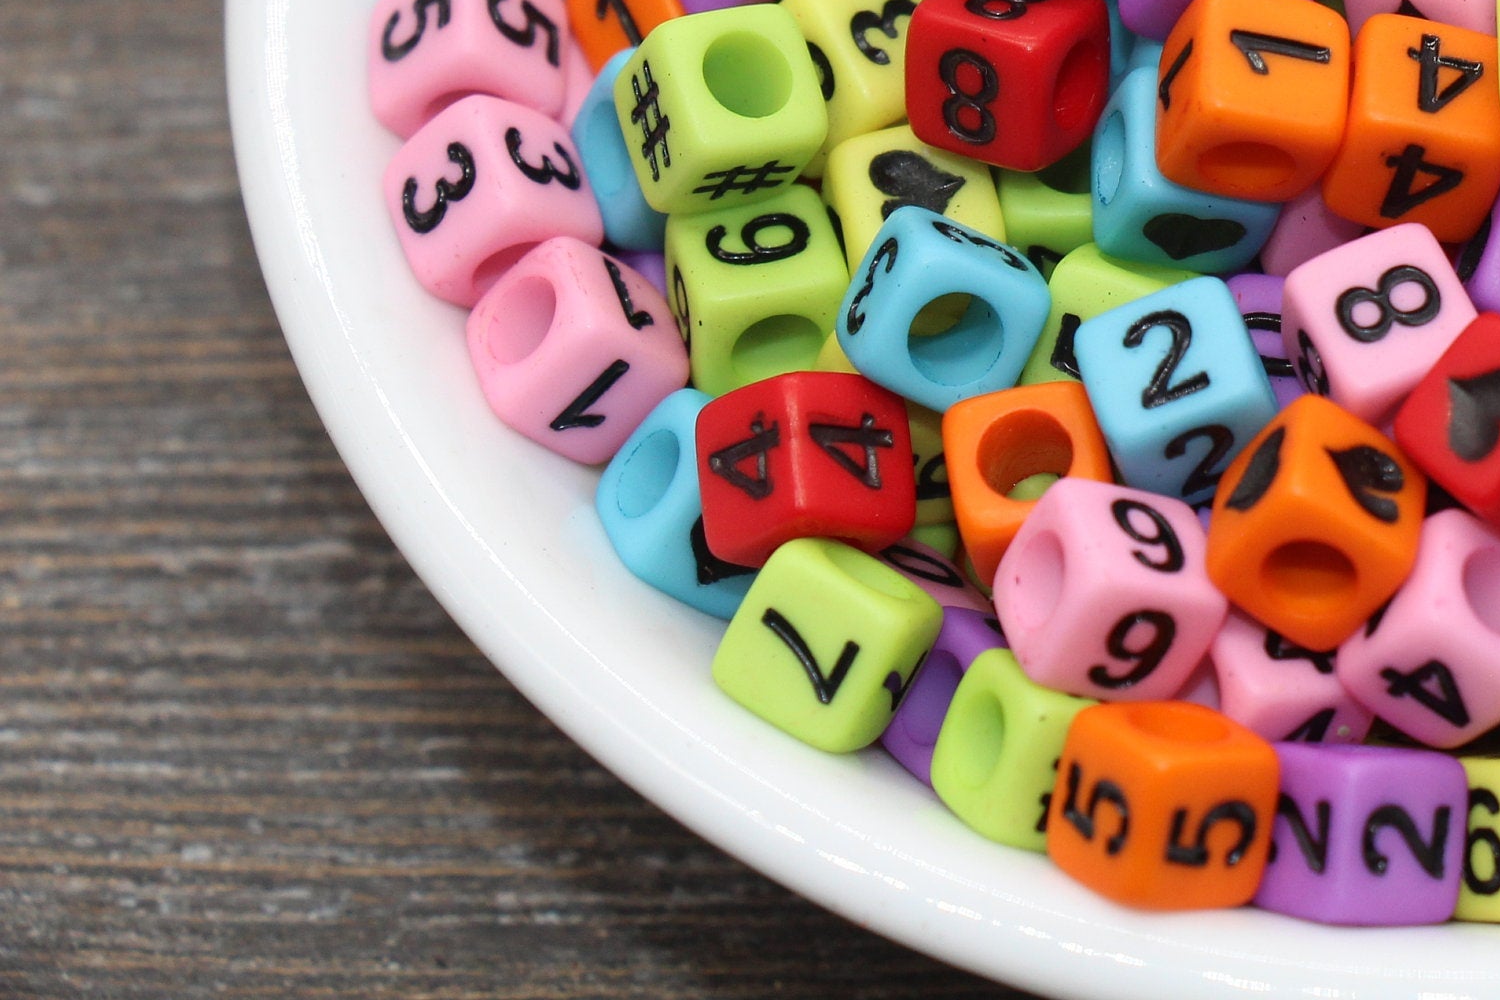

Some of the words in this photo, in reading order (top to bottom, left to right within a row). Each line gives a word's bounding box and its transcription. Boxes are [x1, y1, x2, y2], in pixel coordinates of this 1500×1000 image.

[1230, 28, 1331, 76] 1
[1407, 32, 1485, 113] 4
[630, 58, 671, 183] #
[939, 48, 999, 146] 8
[401, 141, 476, 234] 3
[504, 126, 581, 192] 3
[691, 159, 796, 201] #
[1380, 143, 1464, 219] 4
[846, 236, 899, 336] 3
[1335, 263, 1441, 344] 8
[549, 358, 631, 431] 1
[1122, 309, 1210, 410] 2
[708, 415, 780, 501] 4
[808, 413, 894, 489] 4
[1110, 498, 1186, 574] 9
[761, 607, 861, 705] 7
[1087, 609, 1177, 690] 9
[1379, 659, 1471, 728] 4
[1062, 762, 1130, 856] 5
[1165, 799, 1257, 868] 5
[1362, 803, 1451, 880] 2
